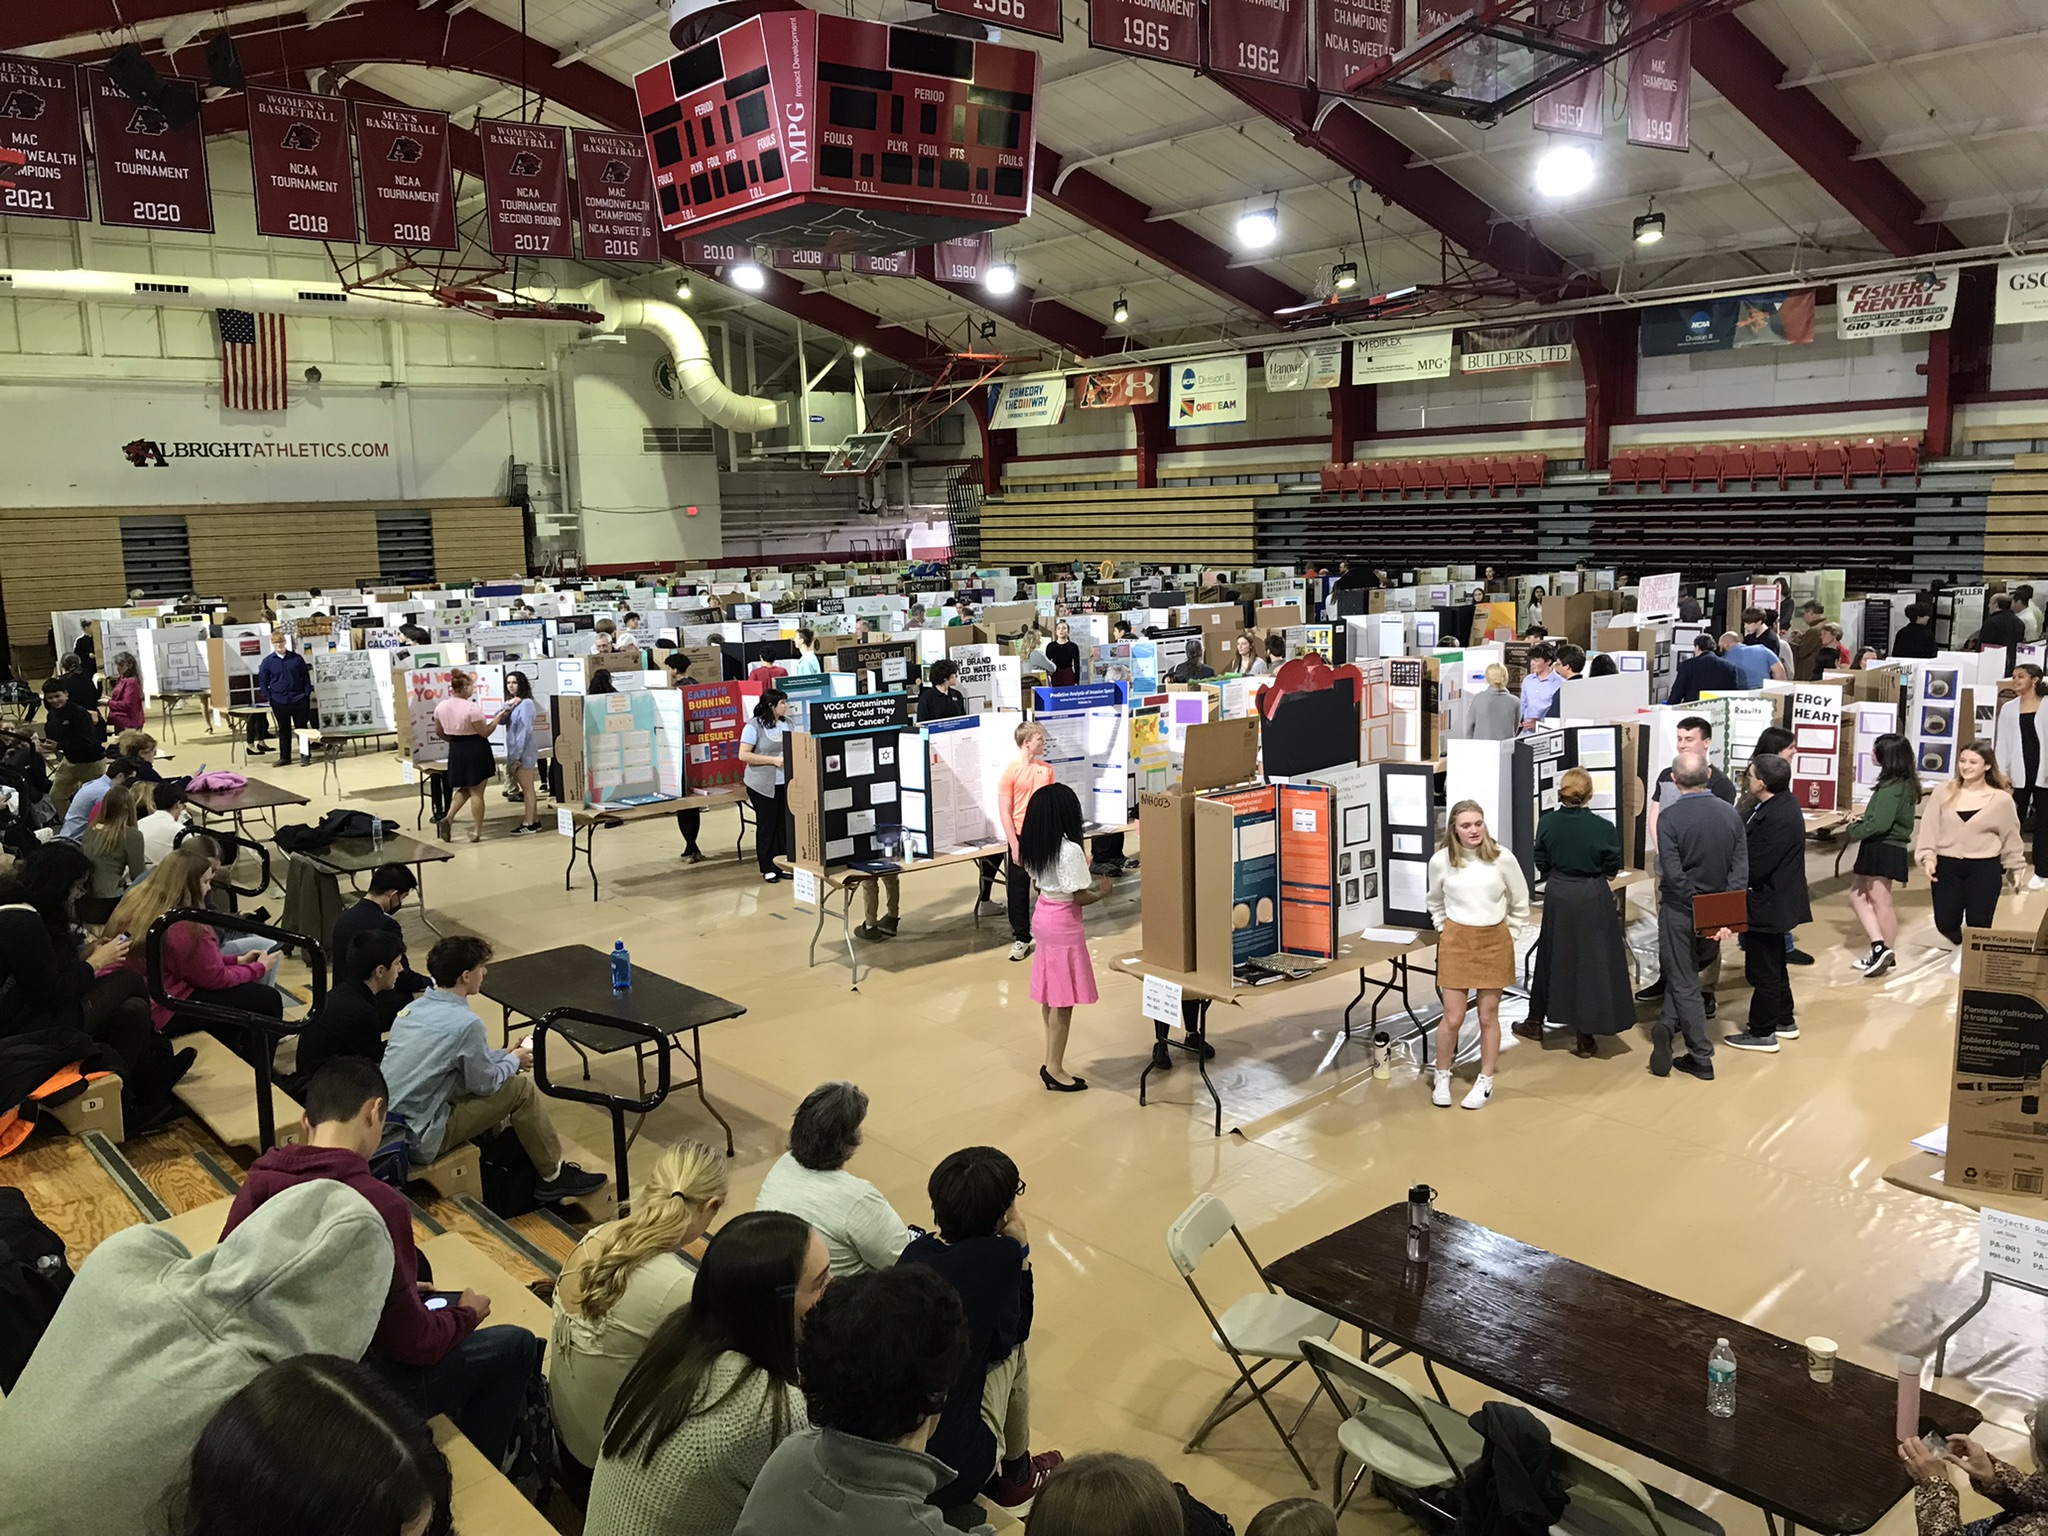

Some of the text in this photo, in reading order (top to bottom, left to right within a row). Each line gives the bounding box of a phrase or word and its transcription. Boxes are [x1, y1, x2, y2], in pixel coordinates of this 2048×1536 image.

[1334, 9, 1388, 33] CHAMPIONS
[1123, 16, 1170, 51] 1965
[1325, 33, 1350, 52] NCAA
[1352, 40, 1383, 58] SWEET
[790, 17, 802, 97] Impact Development
[1238, 42, 1280, 74] 1962
[1651, 59, 1666, 74] MAC
[1642, 74, 1678, 93] CHAMPIONS
[914, 87, 945, 103] PERIOD
[266, 94, 326, 111] WOMEN'S
[694, 100, 714, 117] PERIOD
[258, 103, 338, 123] BASKETBALL
[382, 110, 418, 124] MEN'S
[1554, 104, 1584, 127] 1950
[365, 117, 440, 136] BASKETBALL
[496, 127, 547, 140] WOMEN'S
[786, 103, 808, 164] MPG
[1646, 119, 1672, 141] 1949
[11, 132, 38, 146] MAC
[490, 134, 557, 150] BASKETBALL
[588, 135, 635, 149] WOMEN'S
[756, 133, 776, 151] FOULS
[823, 131, 853, 146] FOULS
[887, 139, 909, 152] PLYR
[135, 149, 167, 163] NCAA
[582, 143, 645, 158] BASKETBALL
[725, 148, 737, 162] PTS
[918, 143, 940, 157] FOUL
[949, 147, 966, 160] PTS
[690, 160, 704, 174] PLYR
[706, 155, 721, 169] FOUL
[998, 153, 1024, 167] FOULS
[114, 161, 190, 180] TOURNAMENT
[289, 163, 319, 177] NCAA
[270, 175, 339, 193] TOURNAMENT
[394, 175, 421, 188] NCAA
[657, 172, 674, 186] FOULS
[516, 187, 541, 199] NCAA
[608, 187, 627, 198] MAC
[854, 180, 879, 194] T.O.L.
[4, 189, 55, 210] 2021
[377, 186, 440, 203] TOURNAMENT
[970, 192, 993, 207] T.O.L.
[500, 199, 558, 214] TOURNAMENT
[585, 197, 651, 211] COMMONWEALTH
[133, 201, 181, 223] 2020
[594, 209, 643, 223] CHAMPIONS
[288, 213, 329, 234] 2018
[498, 212, 562, 227] SECOND ROUND
[393, 223, 432, 242] 2018
[588, 223, 652, 237] NCAA SWEET 16
[514, 234, 550, 252] 2017
[604, 239, 638, 256] 2016
[963, 238, 981, 249] EIGHT
[703, 244, 735, 260] 2010
[792, 250, 821, 264] 2008
[870, 256, 898, 272] 2005
[951, 265, 977, 279] 1980
[1847, 277, 1948, 302] FISHERS
[1853, 292, 1937, 314] RENTAL
[1846, 314, 1945, 332] 610-372-4540
[1358, 337, 1402, 353] MEDIPLEX
[1541, 347, 1569, 362] LTD.
[1417, 358, 1443, 372] MPG
[1198, 375, 1224, 385] Division
[1009, 385, 1044, 398] GAMEDAY
[1196, 400, 1236, 412] ONETEAM
[134, 441, 389, 467] ALBRIGHTATHLETICS.COM
[371, 630, 400, 638] BURNI
[858, 652, 886, 662] BOARD
[966, 656, 992, 666] BRAND
[973, 664, 997, 674] WATER
[960, 673, 991, 683] PUREST?
[414, 687, 444, 702] YOU
[687, 686, 727, 700] EARTH'S
[688, 696, 731, 710] BURNING
[823, 698, 896, 711] VOCs Contaminate
[692, 706, 738, 719] QUESTION
[824, 707, 895, 720] Water: Could They
[1734, 706, 1762, 715] Results
[1794, 708, 1840, 723] HEART
[831, 716, 890, 729] Cause Cancer?
[698, 731, 734, 743] RESULTS
[1971, 934, 1990, 943] Bring
[1991, 934, 2009, 943] Your
[1964, 1005, 2044, 1020] Panneau d'affichage
[1969, 1014, 1988, 1023] trois
[1989, 1015, 2003, 1024] plis
[1961, 1035, 1992, 1046] Tablero
[2020, 1042, 2040, 1051] para
[1961, 1044, 2021, 1057] presentaciones
[89, 1101, 96, 1109] D
[1987, 1213, 2030, 1231] Projects
[1989, 1239, 2021, 1254] PA-001
